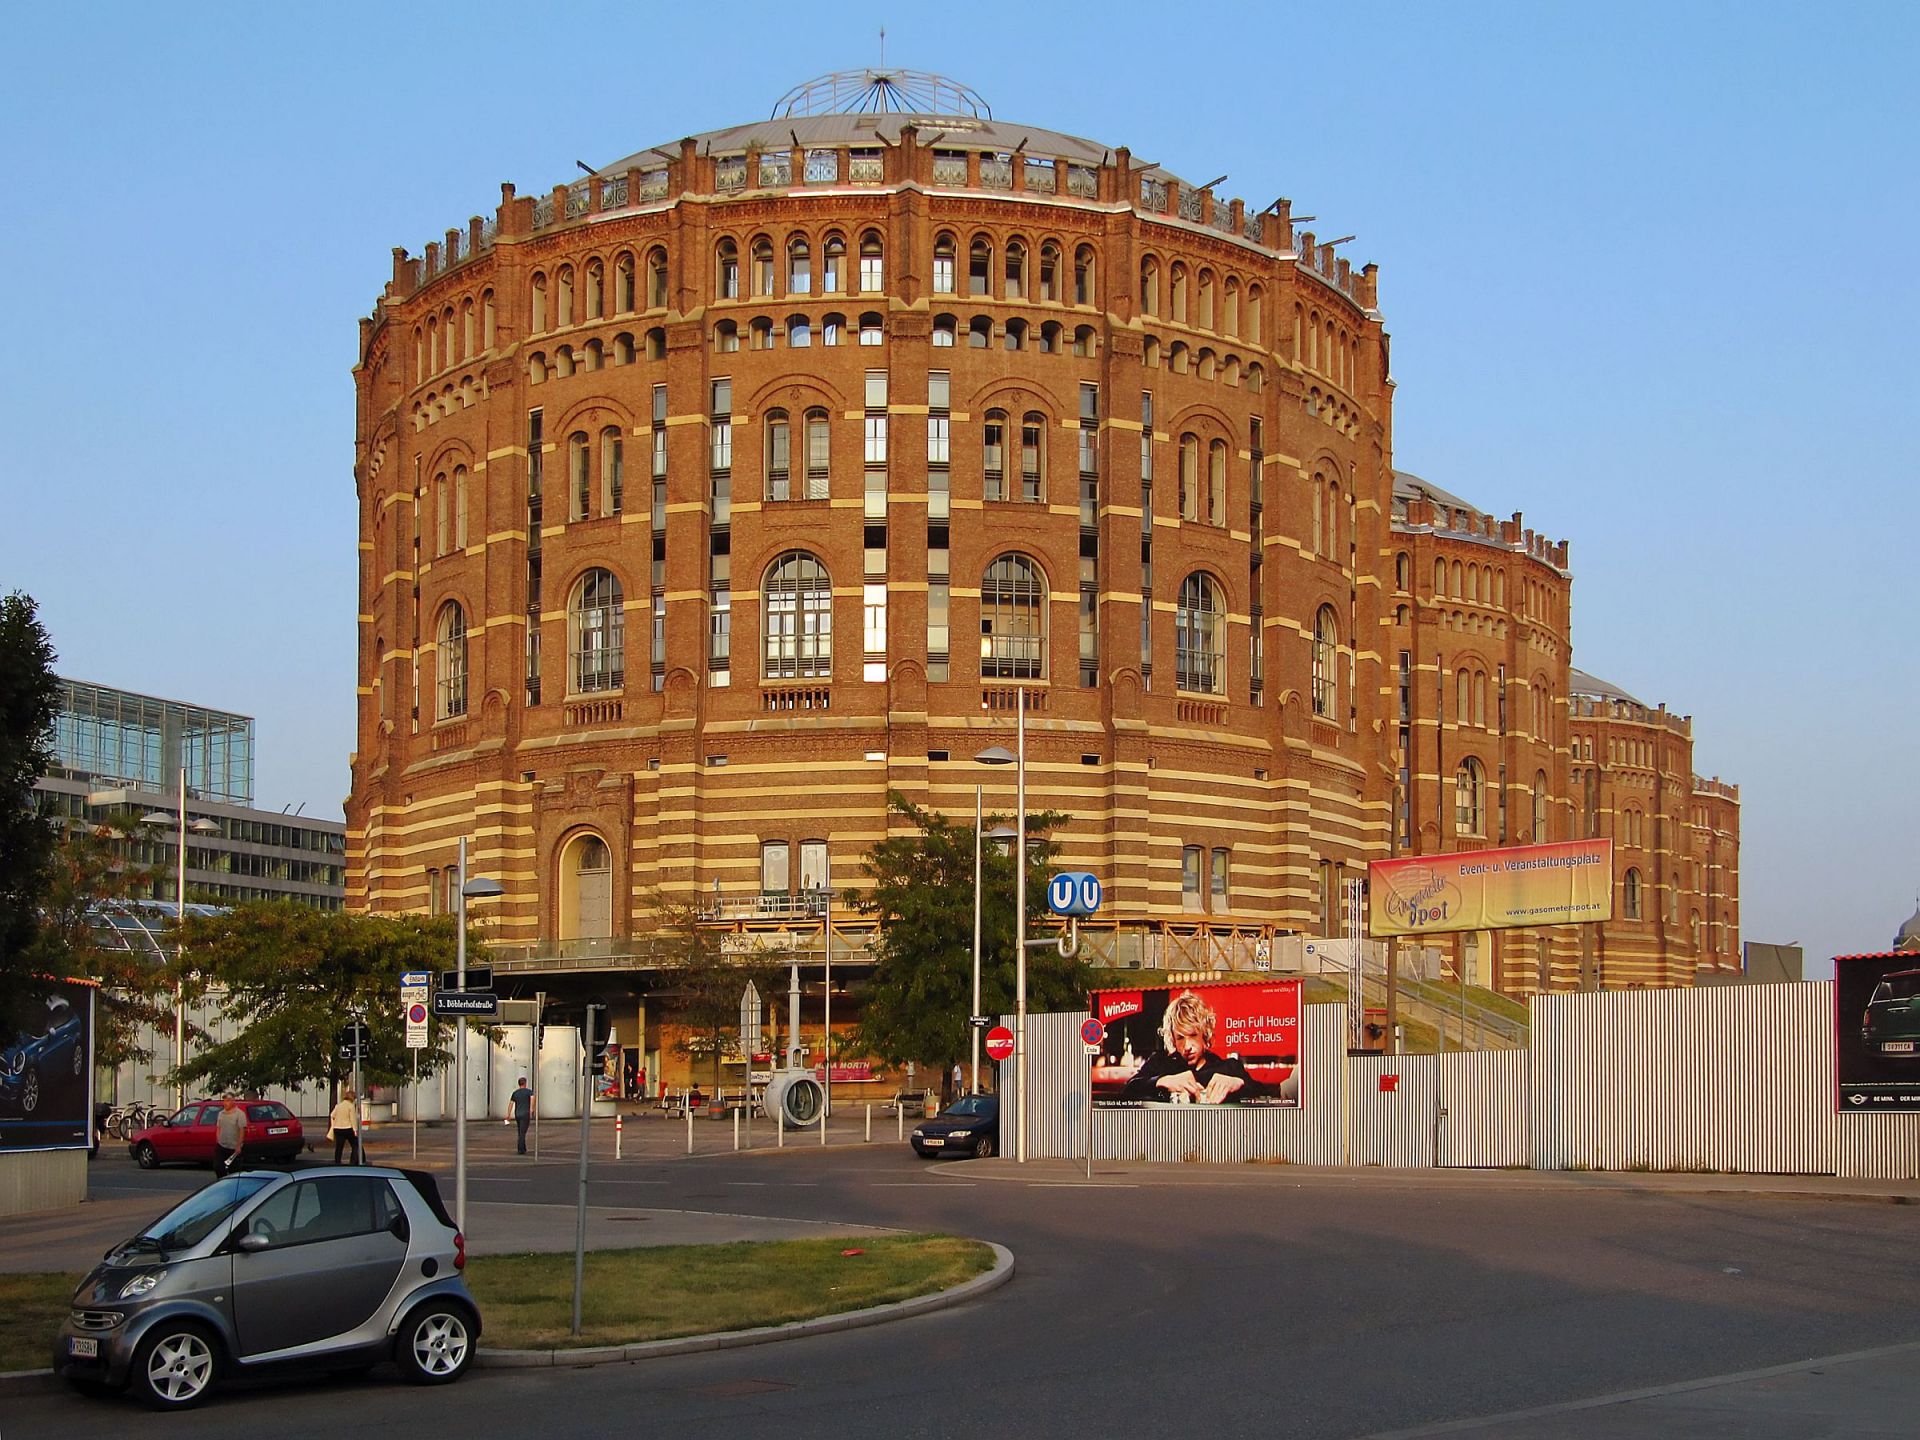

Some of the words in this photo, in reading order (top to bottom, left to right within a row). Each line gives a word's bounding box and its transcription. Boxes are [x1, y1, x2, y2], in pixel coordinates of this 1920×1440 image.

[1460, 864, 1489, 875] Event-
[1492, 863, 1501, 872] u.
[1504, 853, 1601, 871] Veranstaltungsplatz
[1053, 881, 1072, 908] U
[1083, 881, 1098, 908] U
[1505, 903, 1601, 916] www.gasometerspot.at
[438, 1000, 446, 1008] 3.
[446, 1000, 494, 1009] Döblerhofstraße
[1103, 1001, 1139, 1018] win2day
[1225, 1018, 1246, 1029] Dein
[1248, 1016, 1264, 1028] Full
[1266, 1015, 1296, 1027] House
[1225, 1032, 1250, 1047] gibt's
[1252, 1031, 1284, 1043] z'haus.
